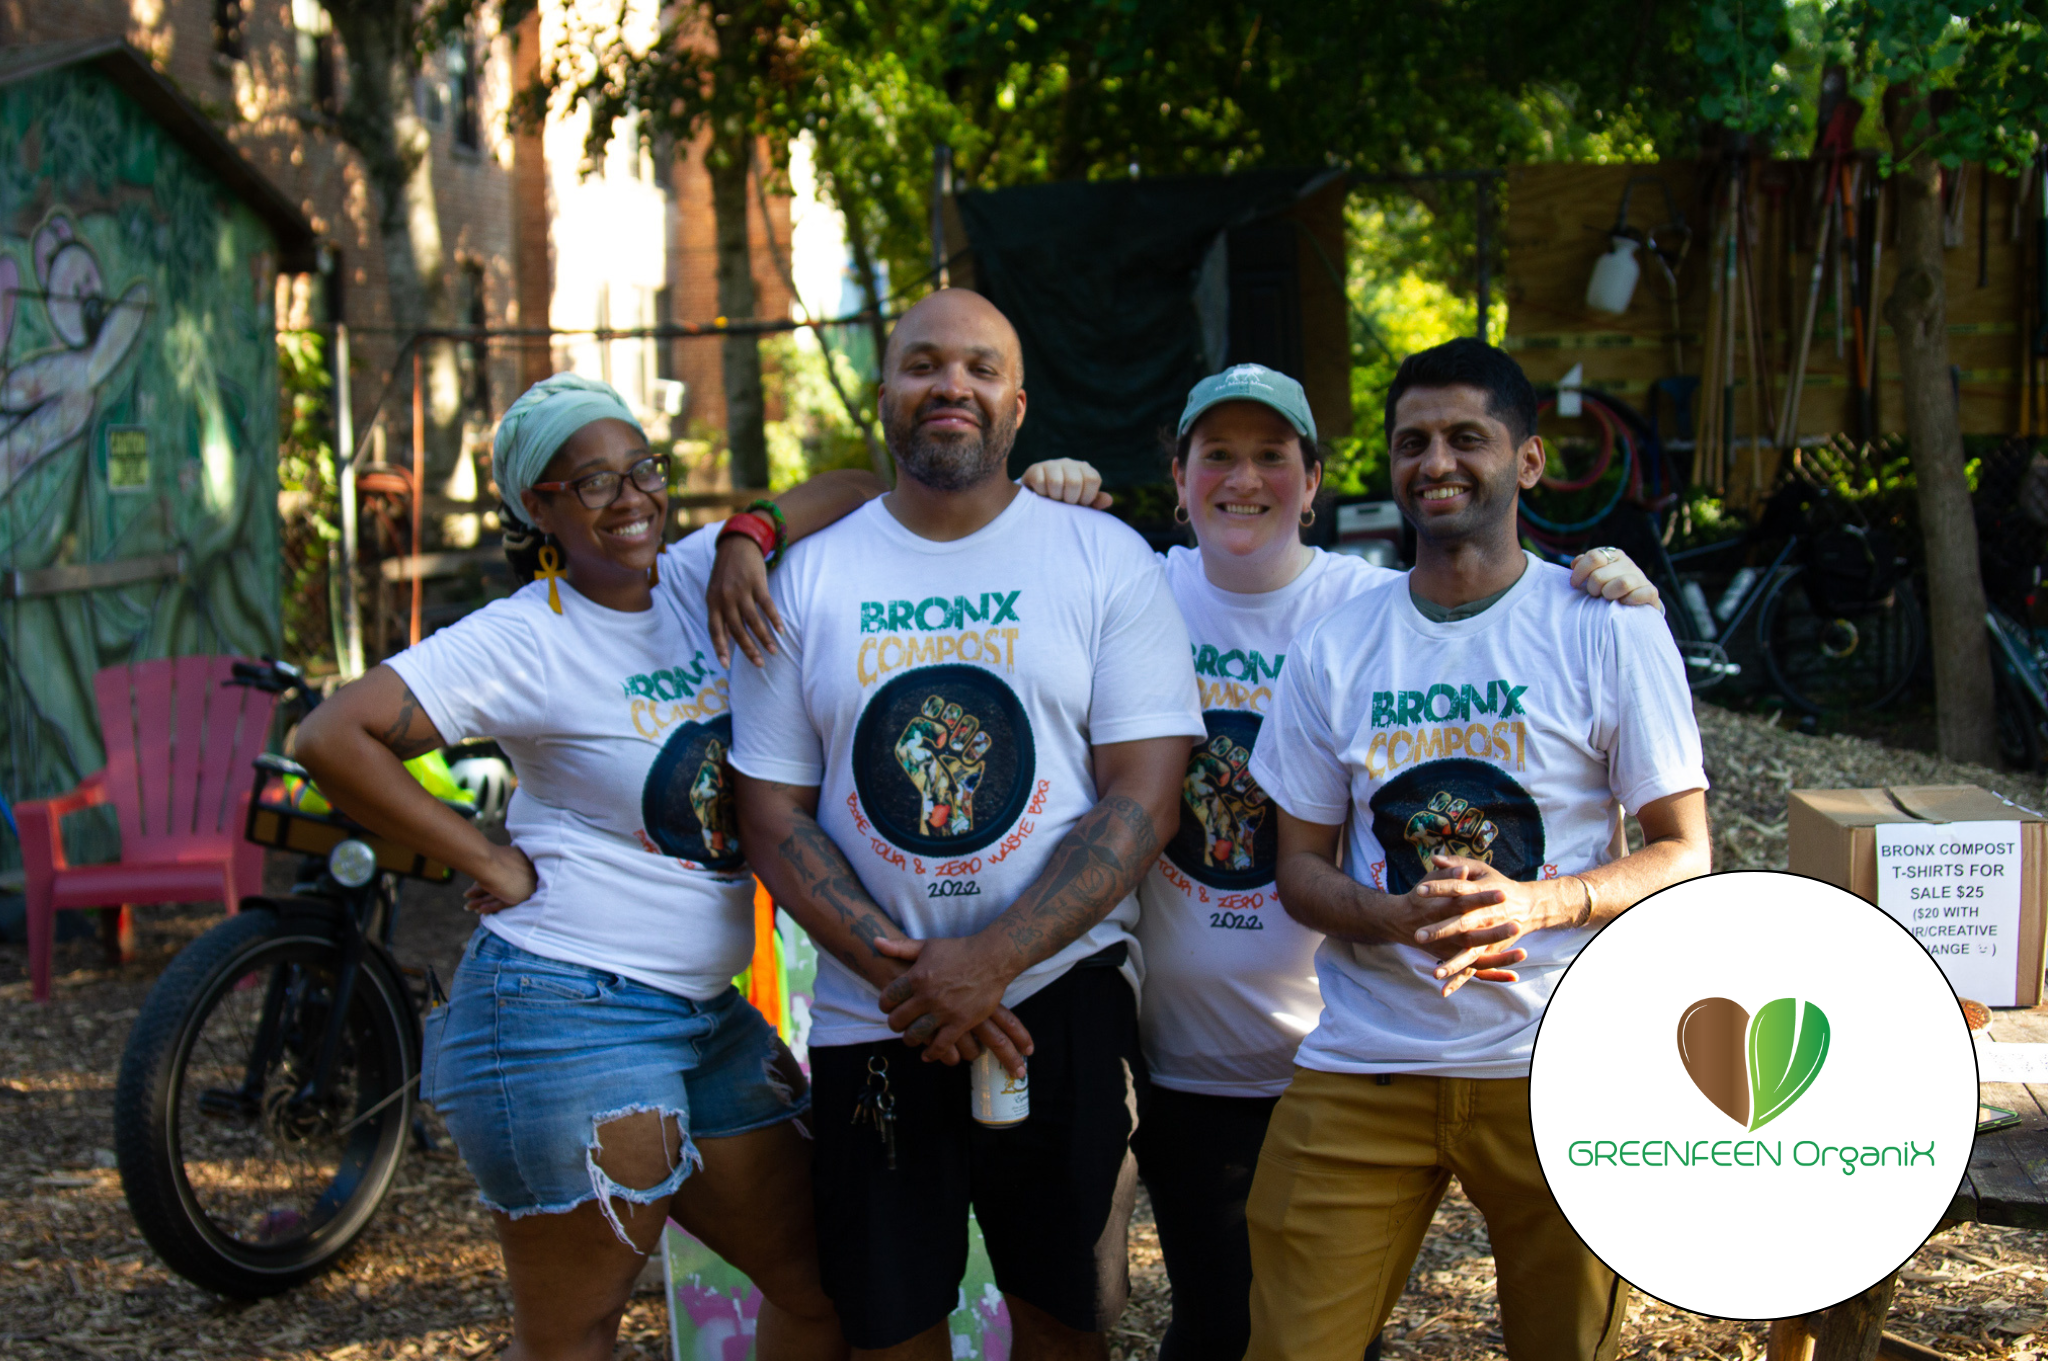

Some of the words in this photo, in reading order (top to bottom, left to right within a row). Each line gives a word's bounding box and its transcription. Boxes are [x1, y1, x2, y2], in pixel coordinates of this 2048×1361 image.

[860, 590, 1021, 635] BRONX
[857, 628, 1019, 688] COMPOST
[1371, 679, 1529, 730] BRONX
[1364, 721, 1527, 780] COMPOST
[913, 858, 925, 874] &
[935, 857, 982, 876] ZERO
[988, 818, 1035, 865] WASTE
[1027, 779, 1050, 814] BBQ
[1881, 843, 1935, 857] BRONX
[1940, 842, 2015, 855] COMPOST
[1892, 864, 1964, 878] T-SHIRTS
[1970, 864, 2004, 877] FOR
[927, 879, 982, 898] 2022
[1199, 886, 1209, 903] &
[1217, 892, 1264, 910] ZERO
[1911, 886, 1951, 900] SALE
[1957, 885, 1984, 899] $25
[1210, 912, 1263, 929] 2022
[1913, 908, 1939, 921] ($20
[1944, 907, 1979, 917] WITH
